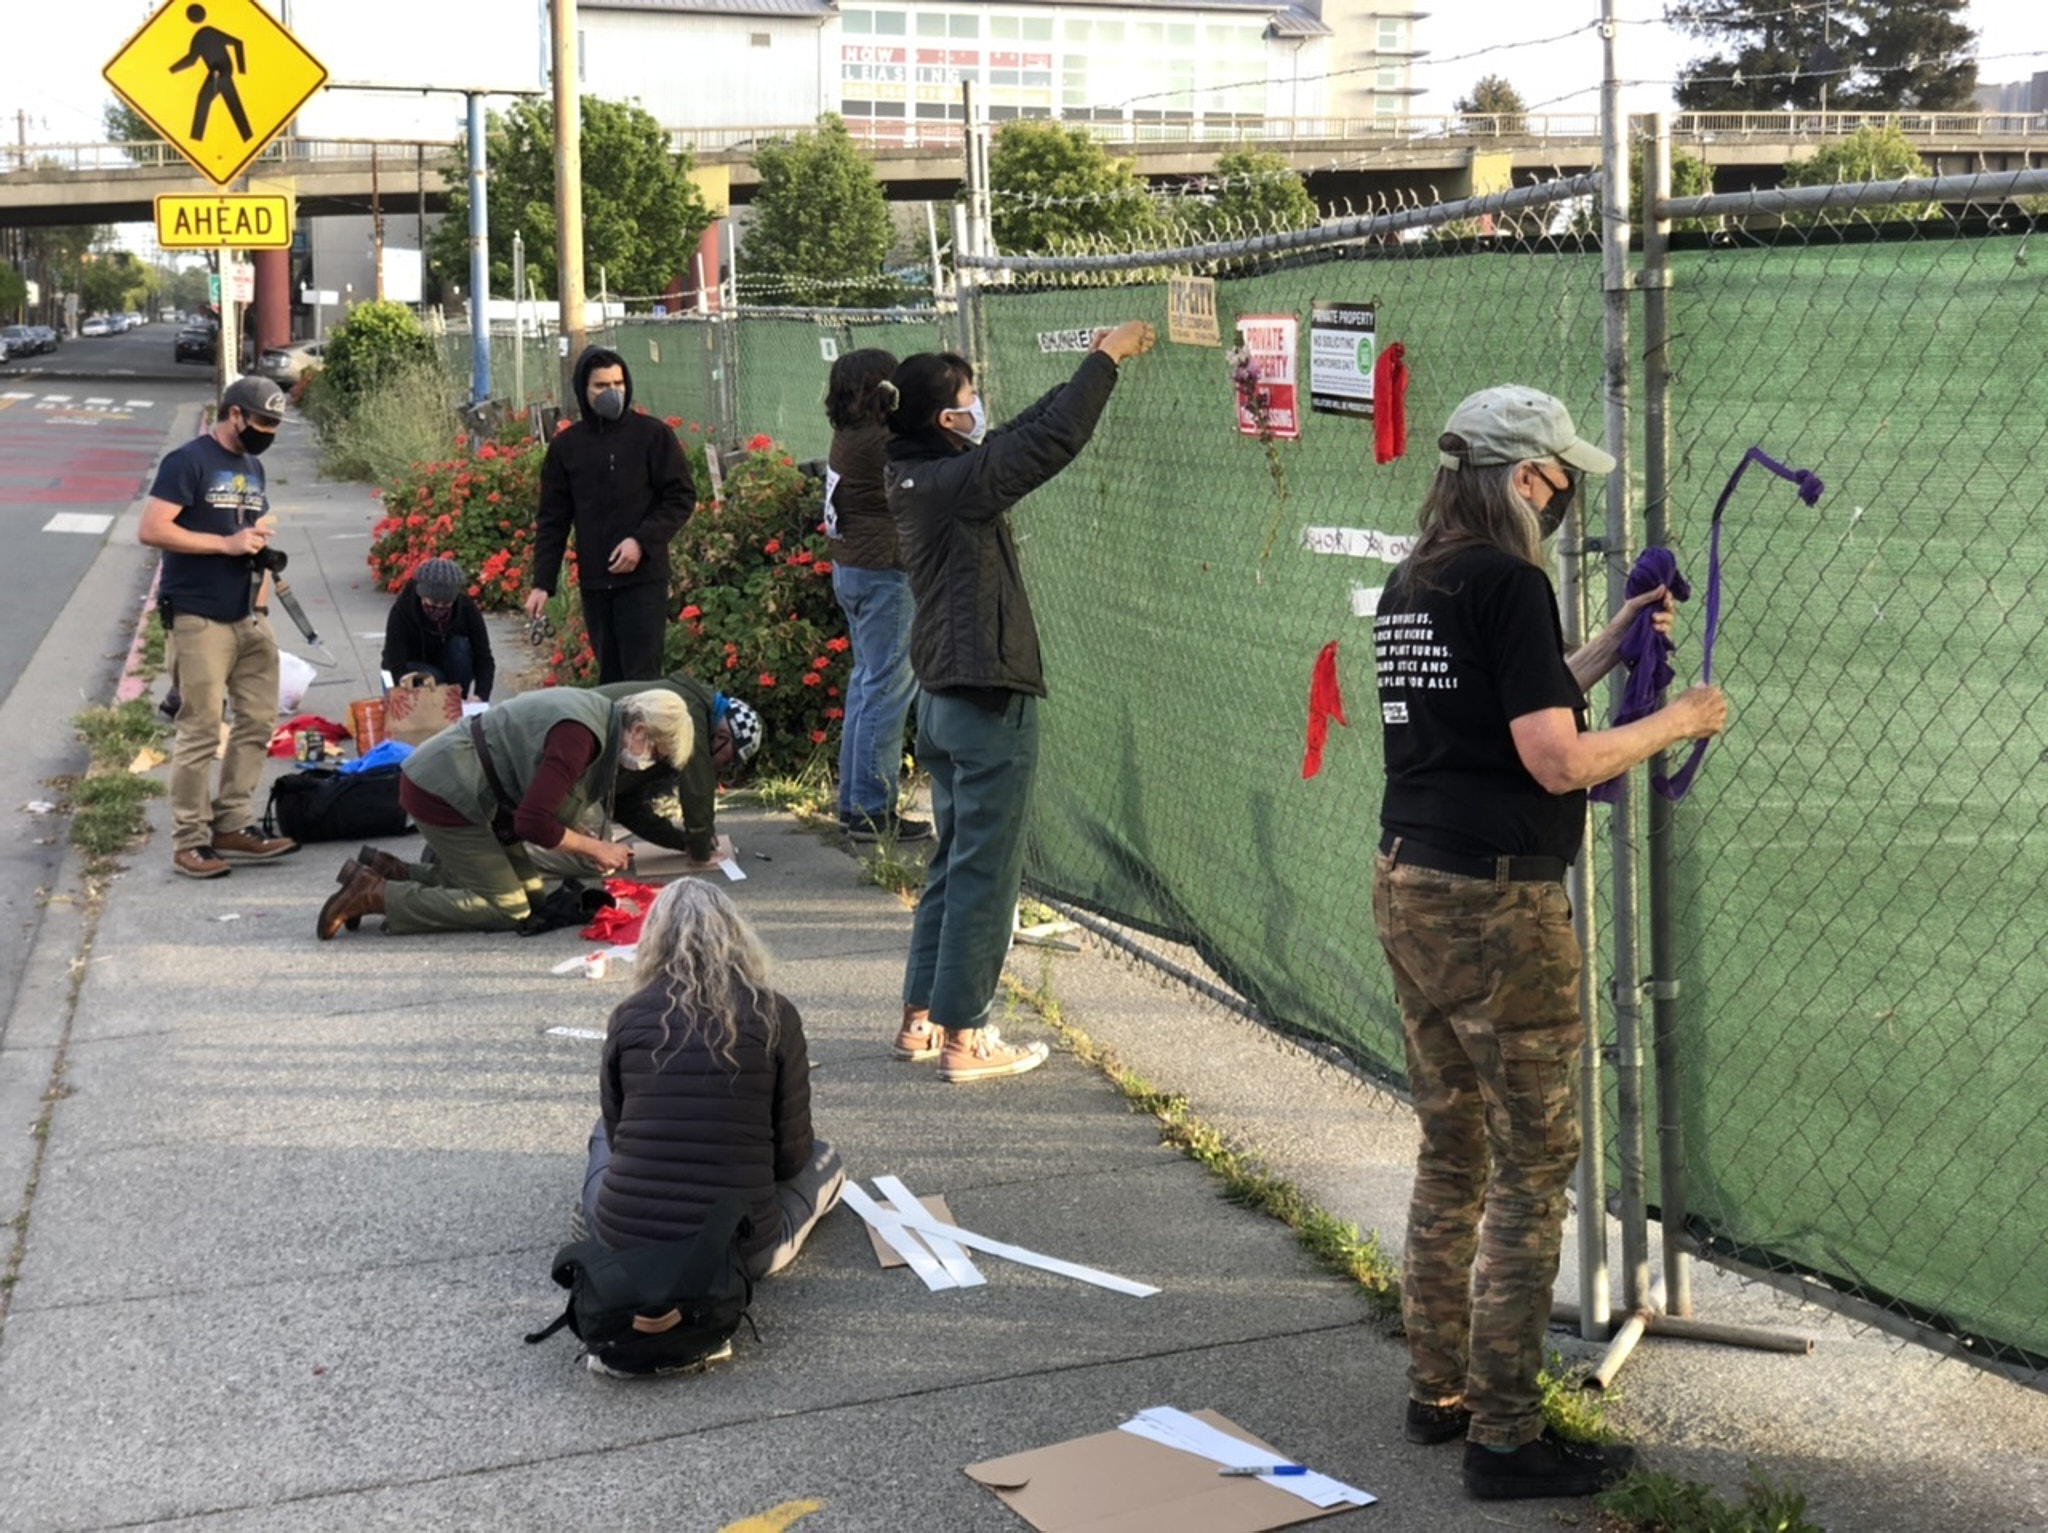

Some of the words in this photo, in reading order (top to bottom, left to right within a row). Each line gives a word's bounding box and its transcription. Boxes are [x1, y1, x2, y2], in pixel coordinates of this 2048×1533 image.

[845, 46, 893, 63] NOW
[844, 65, 960, 83] LEASING
[174, 206, 272, 235] AHEAD
[1312, 308, 1339, 324] PRIVATE
[1339, 309, 1374, 326] PROPERTY
[1247, 327, 1283, 350] PRIVATE
[1313, 334, 1322, 347] NO
[1323, 335, 1355, 350] SOLICITING
[1417, 613, 1432, 625] US.
[1404, 629, 1433, 641] RICHER
[1412, 645, 1452, 658] BURNS.
[1421, 661, 1448, 673] AND
[1428, 677, 1457, 689] ALL!
